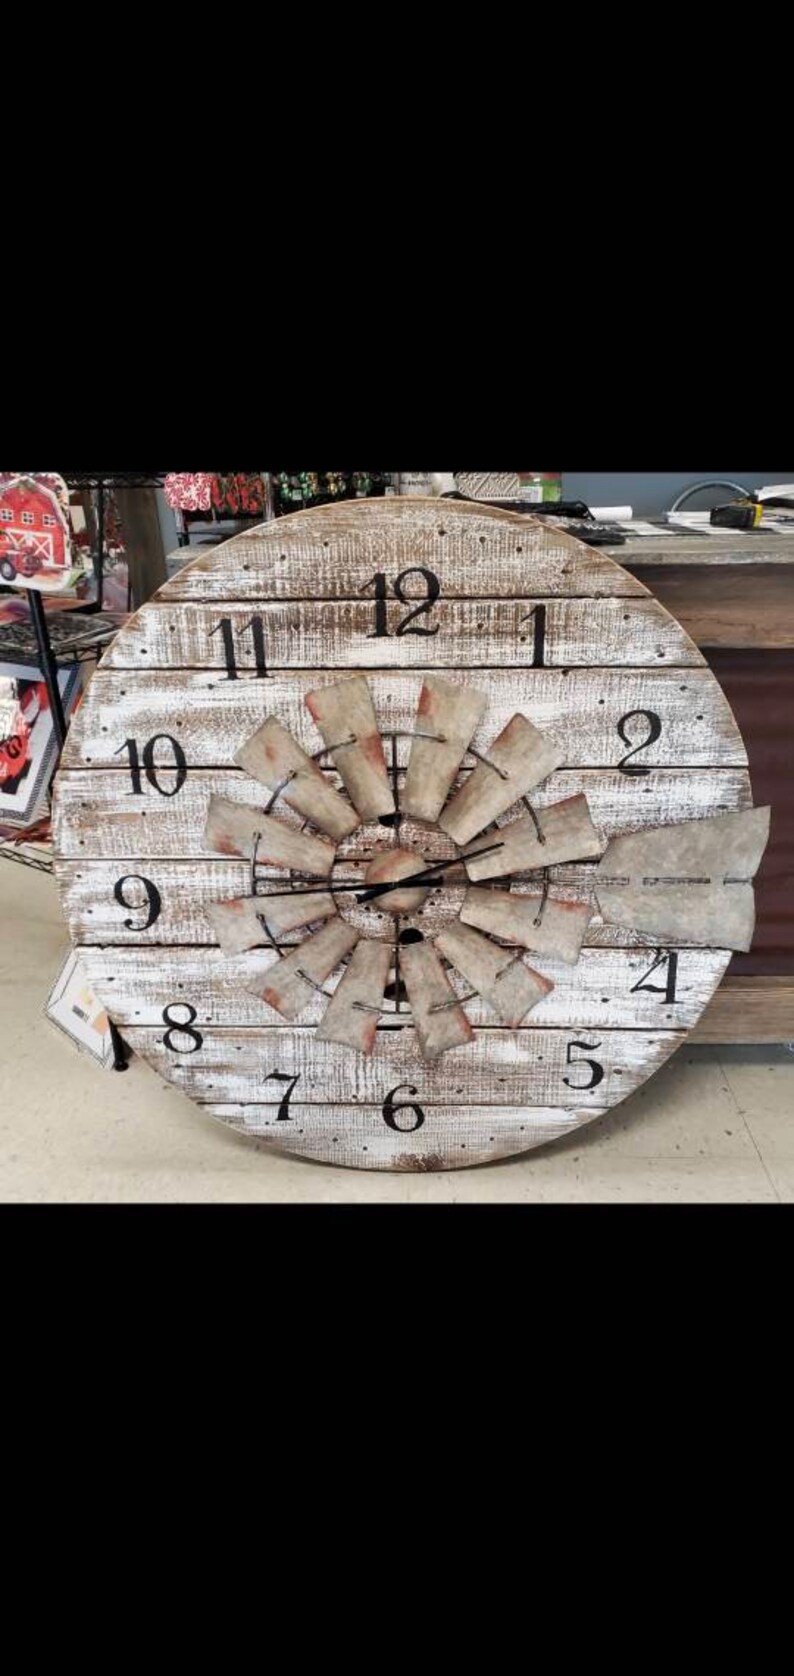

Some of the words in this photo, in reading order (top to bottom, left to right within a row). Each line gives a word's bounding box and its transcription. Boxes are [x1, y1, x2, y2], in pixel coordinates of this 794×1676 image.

[360, 567, 440, 638] 12
[208, 617, 269, 680] 11
[521, 606, 546, 668] 1
[115, 735, 187, 797] 10
[617, 710, 662, 776] 2
[114, 876, 162, 931] 9
[630, 948, 679, 1004] 4
[162, 1003, 204, 1053] 8
[563, 1041, 605, 1089] 5
[264, 1073, 300, 1121] 7
[382, 1085, 424, 1132] 6
